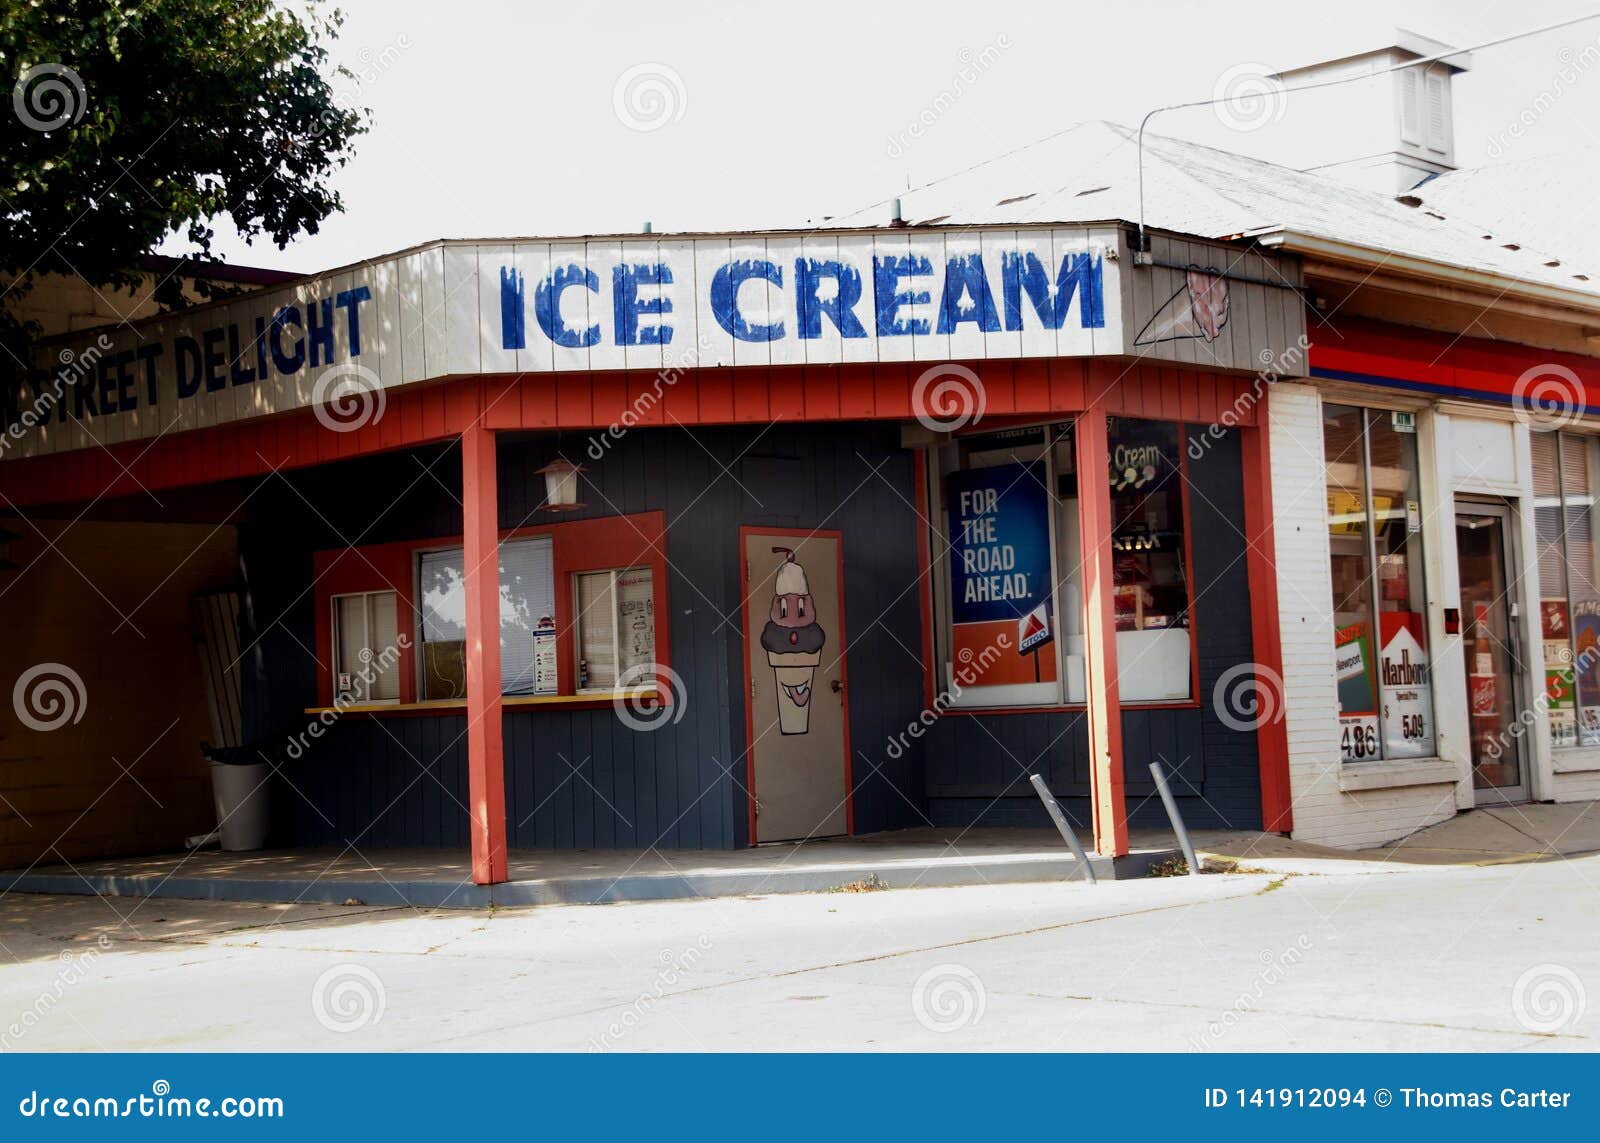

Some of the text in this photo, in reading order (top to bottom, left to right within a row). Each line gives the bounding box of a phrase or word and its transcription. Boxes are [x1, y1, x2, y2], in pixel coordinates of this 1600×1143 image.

[500, 250, 1105, 349] ICE CREAM
[174, 286, 372, 400] DELIGHT
[1115, 444, 1160, 471] Cream
[960, 488, 999, 517] FOR
[961, 517, 998, 545] THE
[964, 545, 1015, 574] ROAD
[964, 573, 1032, 603] AHEAD.
